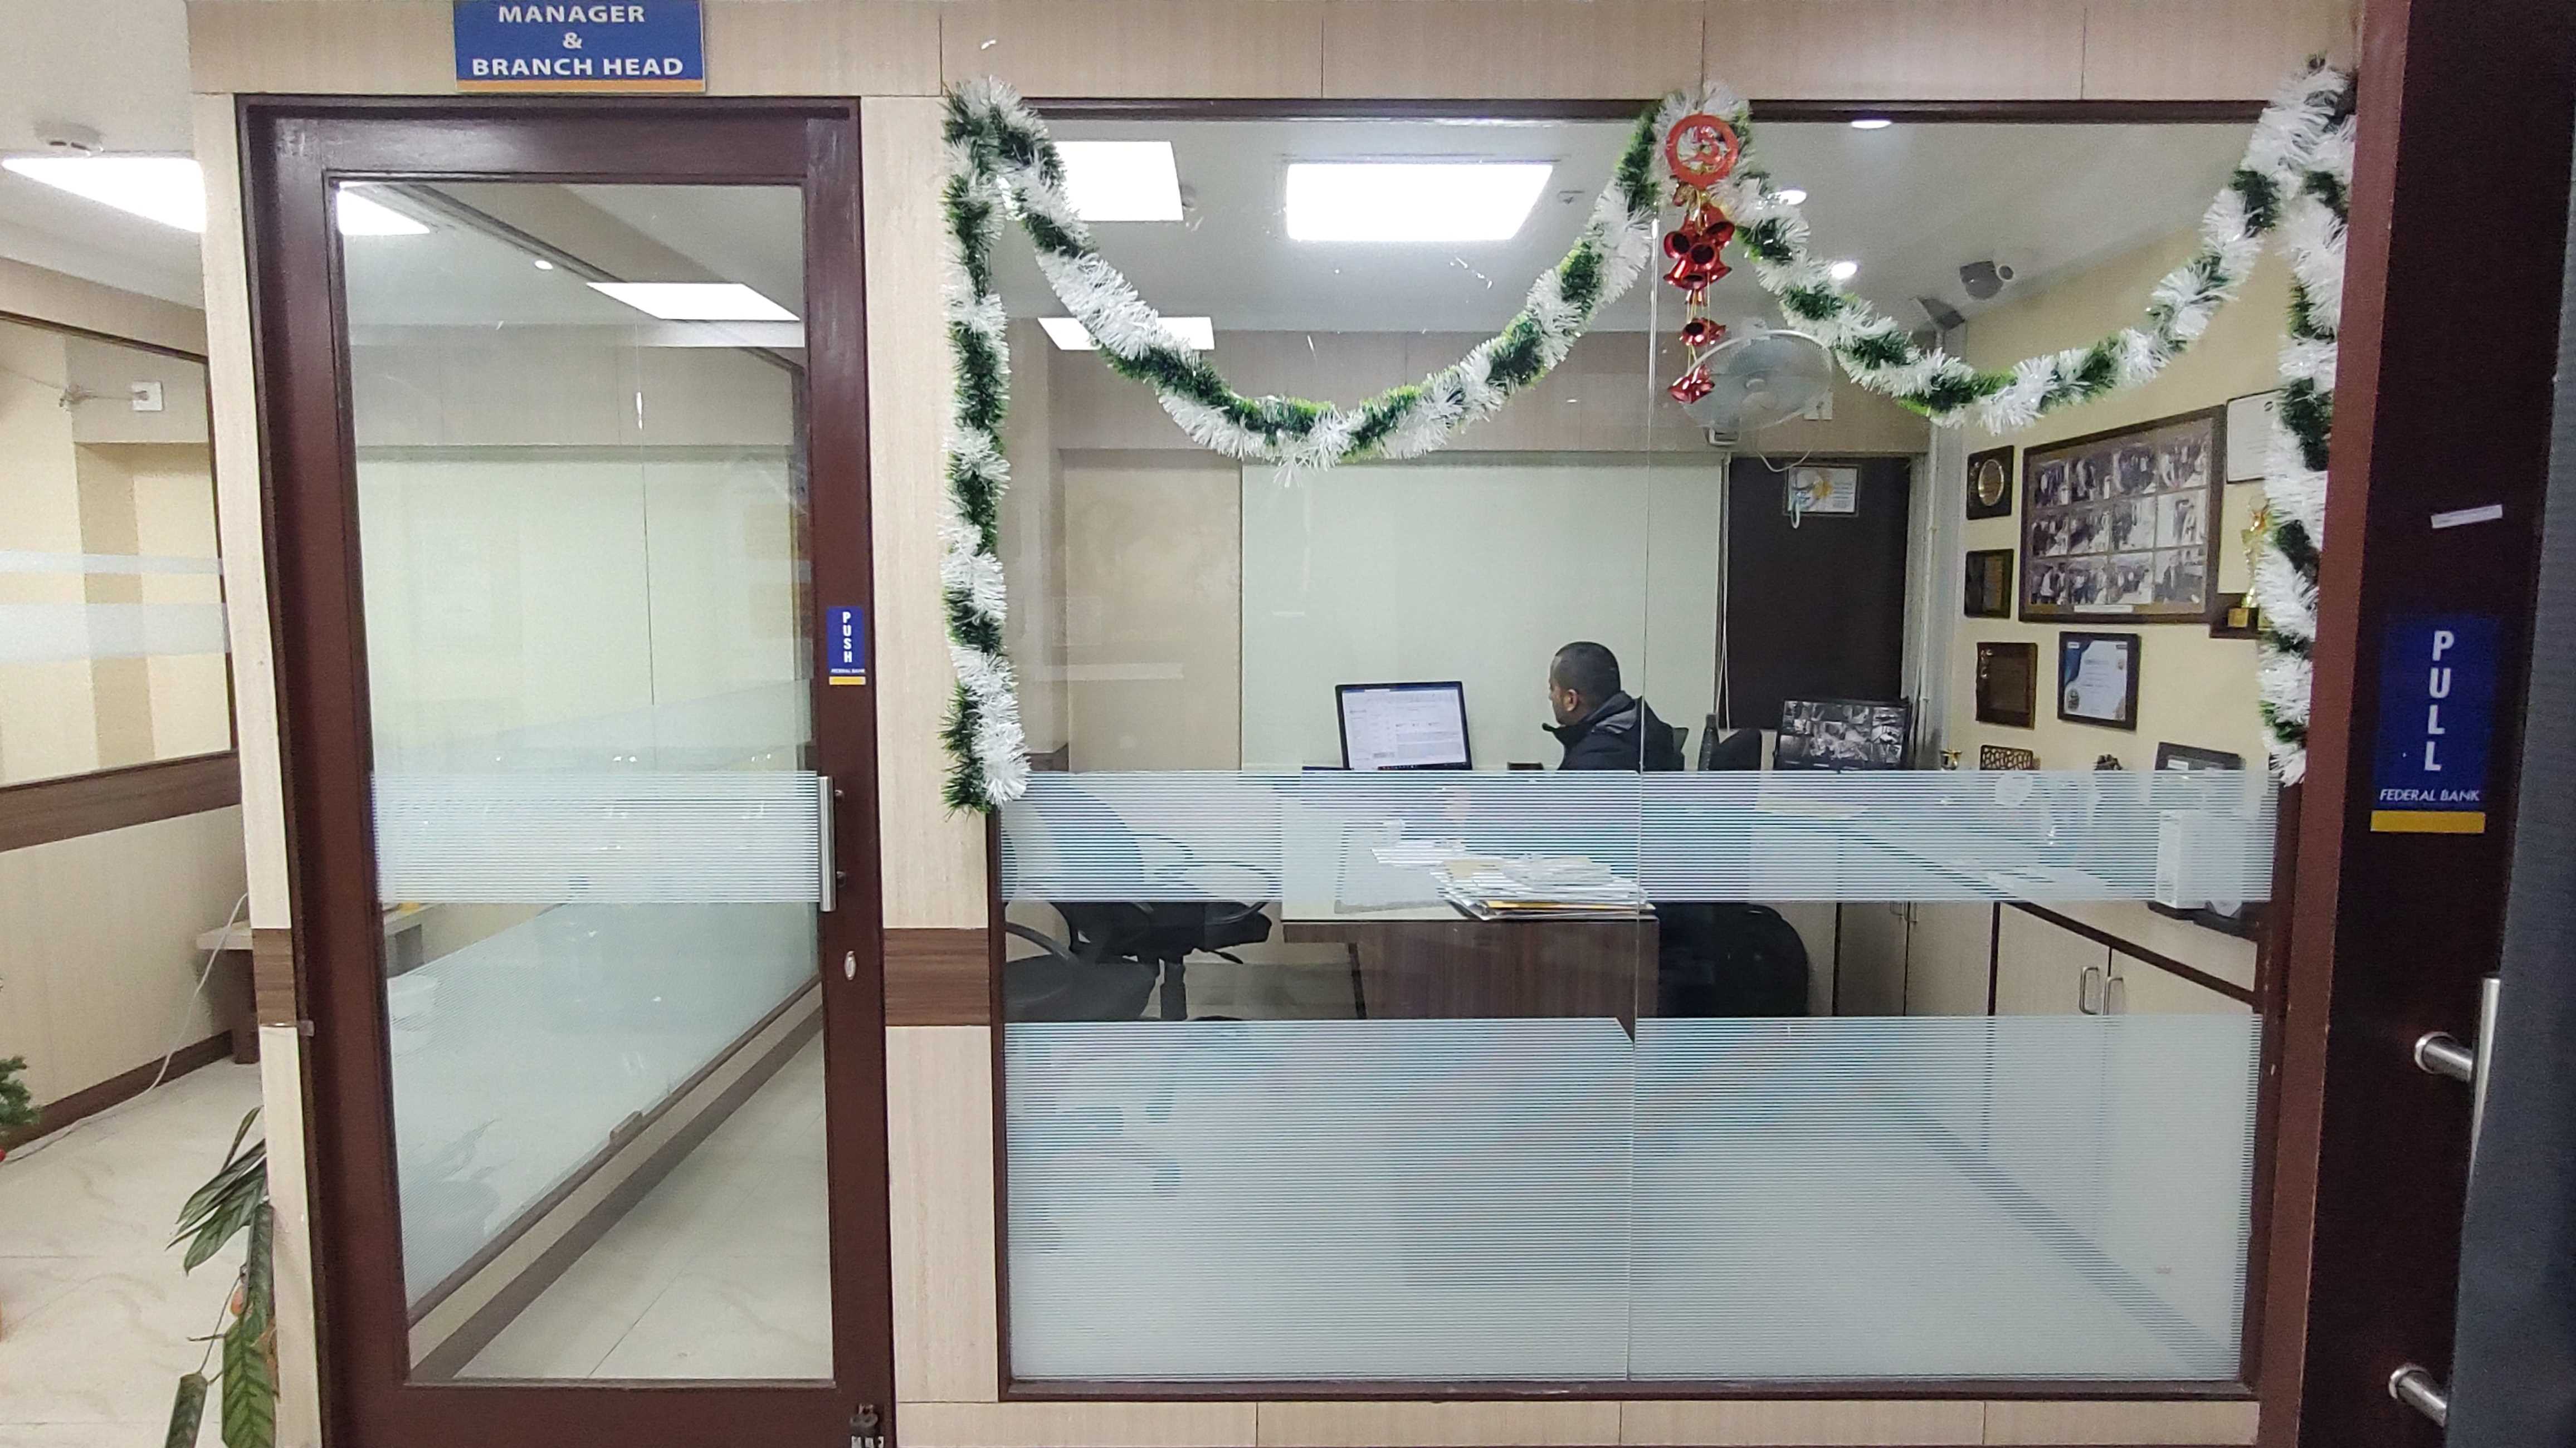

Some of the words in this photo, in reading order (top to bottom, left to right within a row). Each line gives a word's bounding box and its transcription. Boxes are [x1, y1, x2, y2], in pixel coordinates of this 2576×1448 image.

[499, 6, 645, 22] MANAGER
[563, 32, 582, 49] &
[472, 58, 592, 76] BRANCH
[603, 58, 684, 75] HEAD
[842, 612, 852, 663] PUSH
[2424, 630, 2455, 771] PULL
[2380, 789, 2436, 801] FEDERAL
[2440, 789, 2480, 802] BANK
